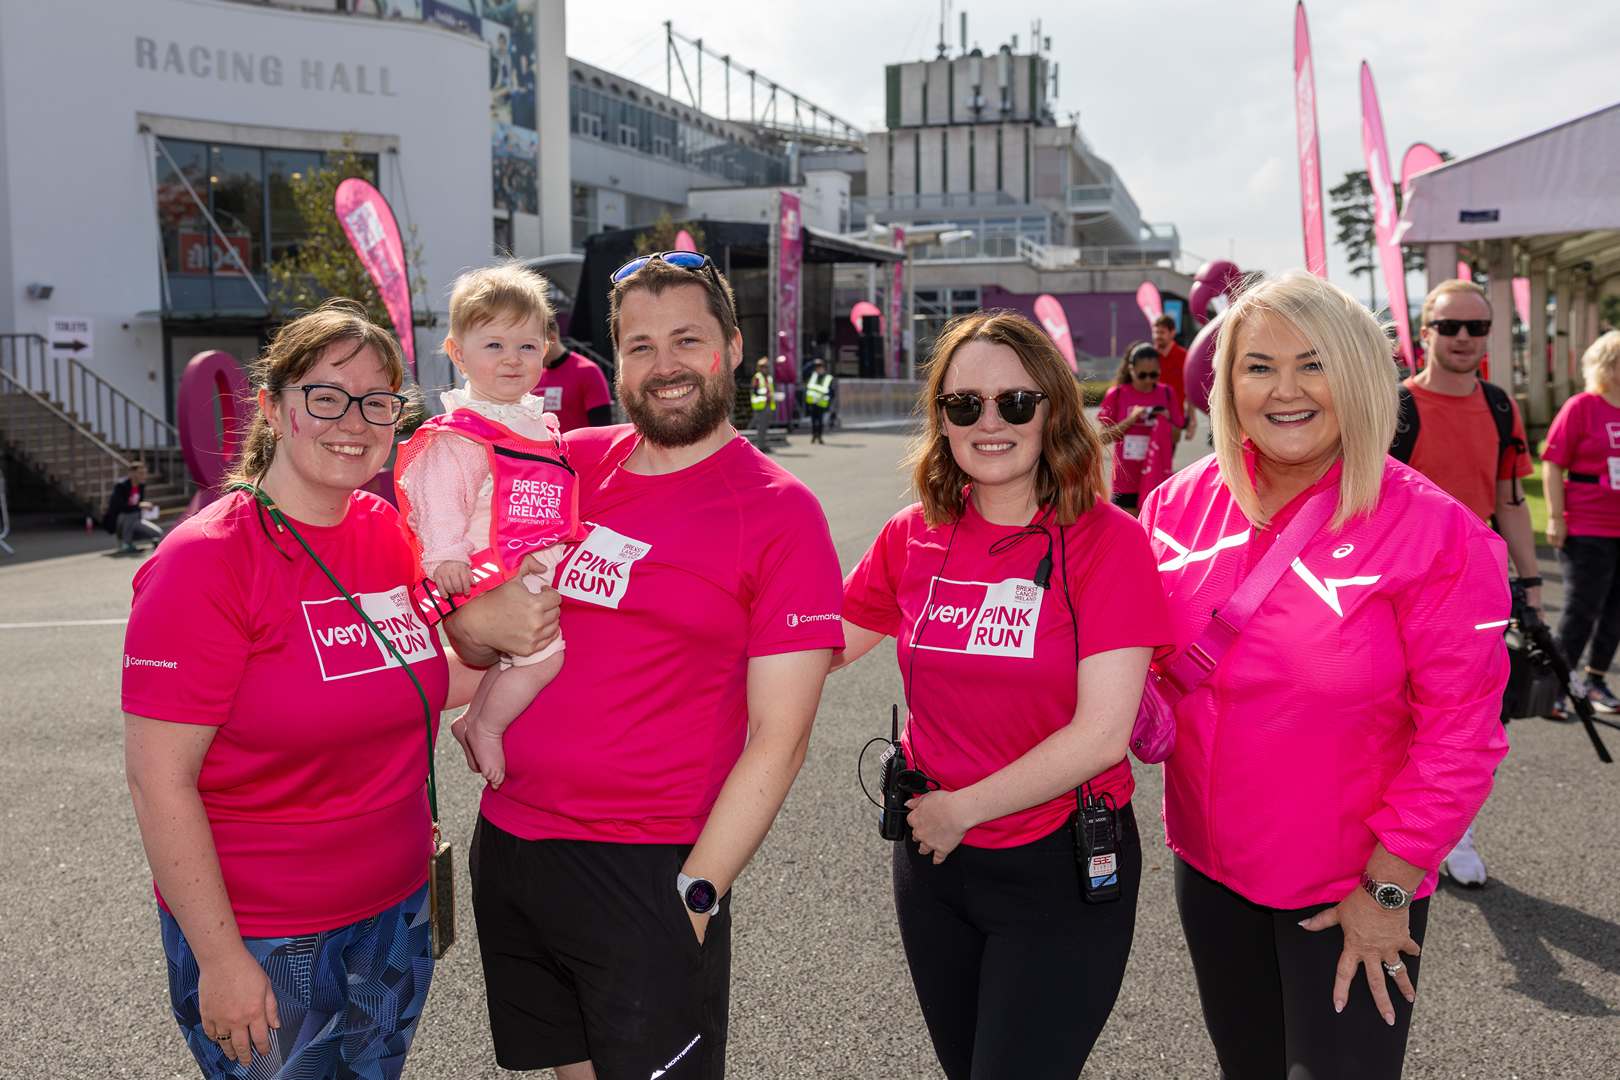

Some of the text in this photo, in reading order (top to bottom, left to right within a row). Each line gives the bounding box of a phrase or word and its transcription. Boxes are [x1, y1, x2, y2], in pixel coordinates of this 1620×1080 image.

[135, 36, 398, 97] RACING HALL
[508, 505, 561, 519] IRELAND
[509, 493, 561, 510] CANCER
[573, 549, 628, 580] PINK
[564, 568, 616, 598] RUN
[372, 612, 422, 637] PINK
[928, 604, 977, 630] very
[979, 605, 1034, 627] PINK
[316, 622, 367, 648] very
[973, 626, 1024, 648] RUN
[130, 656, 178, 670] Cornmarket
[664, 1033, 701, 1070] MONTERRAIN
